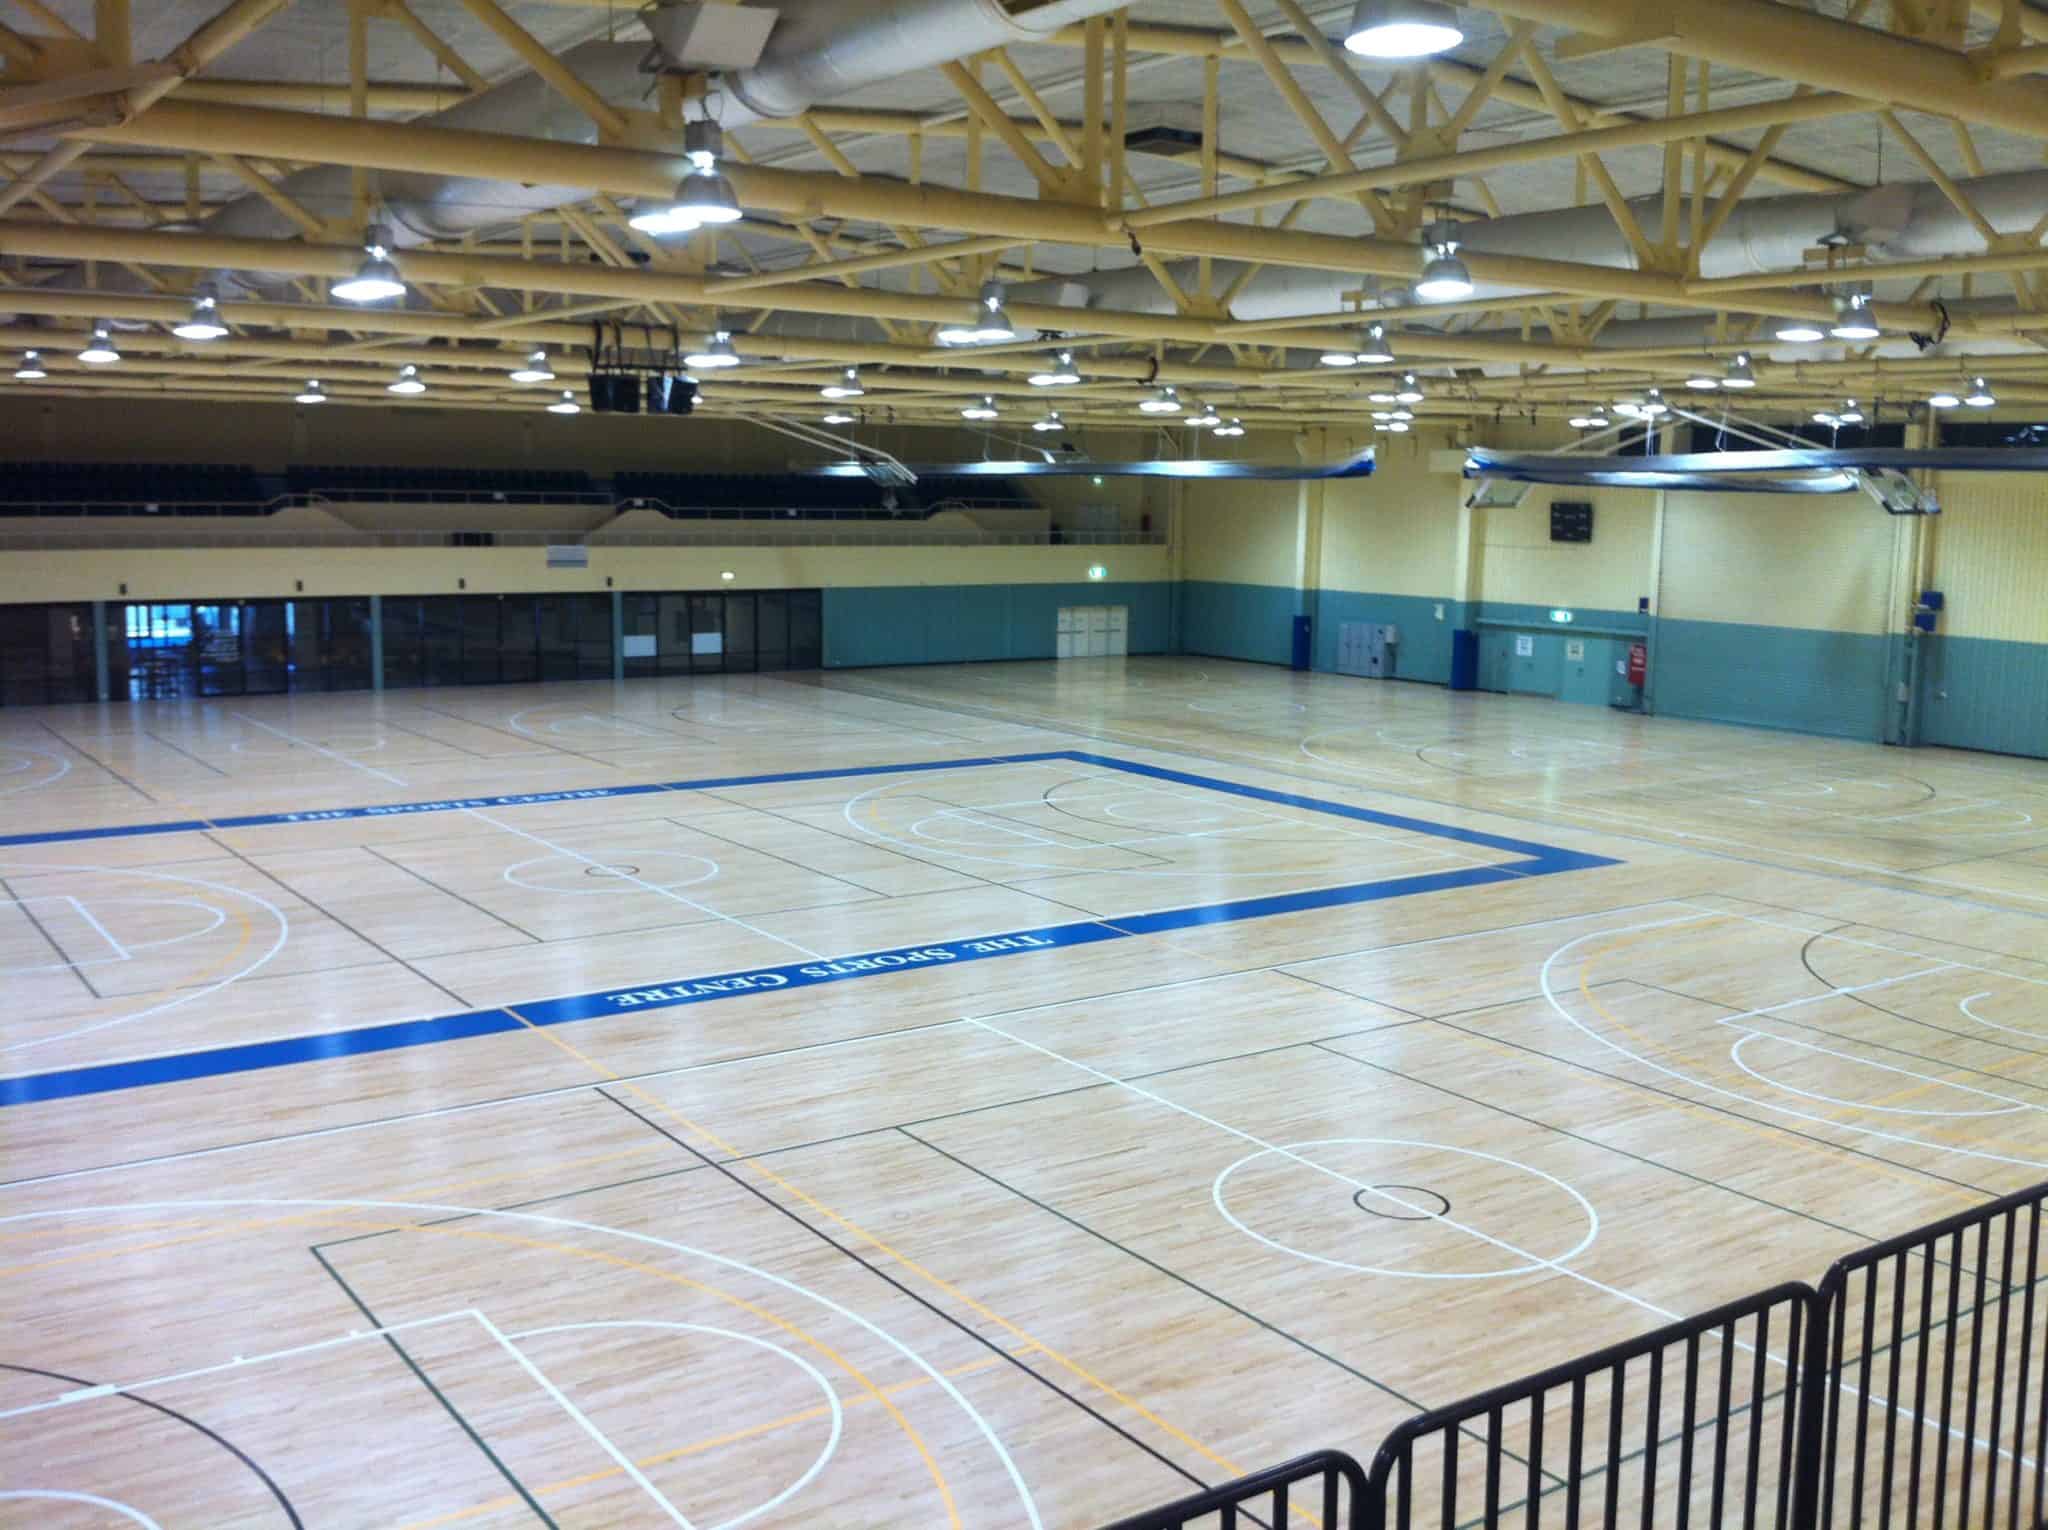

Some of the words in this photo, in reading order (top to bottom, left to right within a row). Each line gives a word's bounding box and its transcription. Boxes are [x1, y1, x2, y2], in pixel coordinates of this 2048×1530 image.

[963, 934, 1055, 954] THE
[799, 947, 957, 977] SPORTS
[606, 973, 789, 1007] CENTRE
